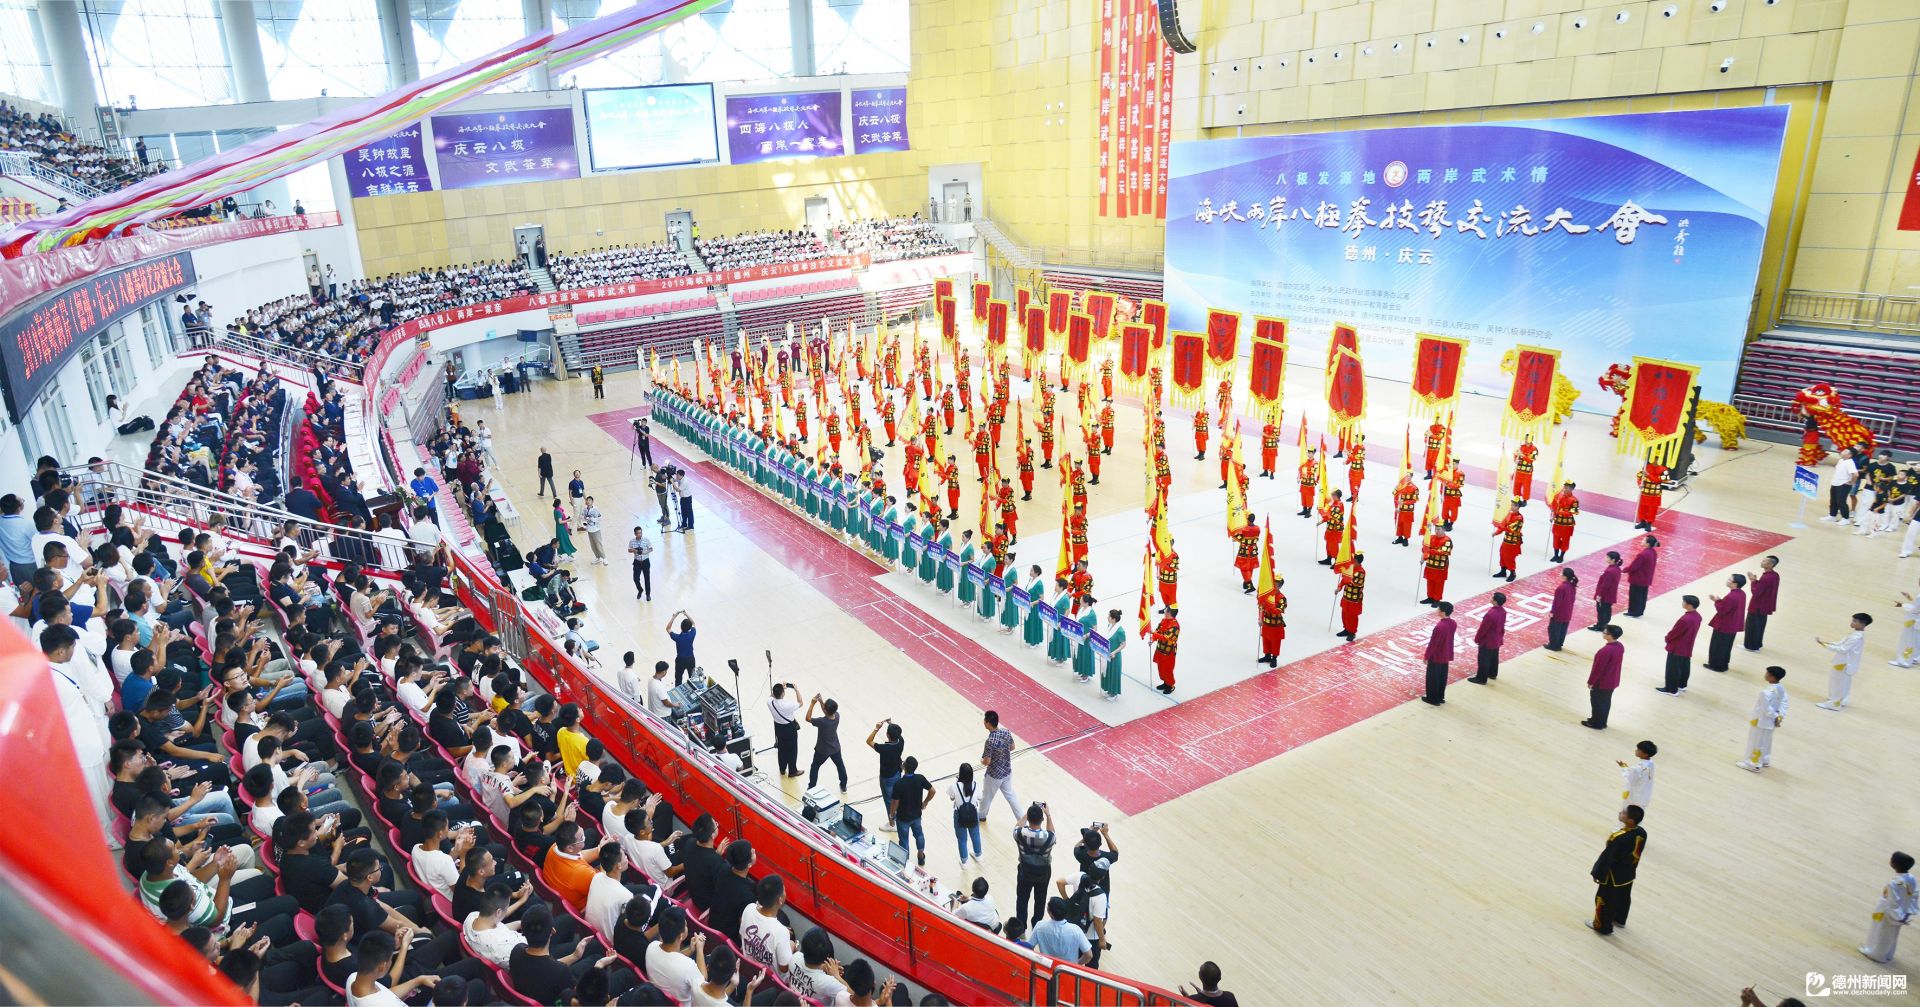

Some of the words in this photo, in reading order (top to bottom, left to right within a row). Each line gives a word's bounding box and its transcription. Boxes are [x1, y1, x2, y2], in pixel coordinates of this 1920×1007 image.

[739, 119, 809, 135] 四海八极人
[858, 113, 901, 127] 庆云八极
[860, 131, 903, 145] 文武荟萃
[358, 146, 412, 162] 吴钟故里
[454, 139, 526, 156] 庆云八极
[362, 162, 415, 178] 八极之源
[485, 157, 555, 174] 文武荟萃
[1276, 171, 1376, 186] 八极发源地
[1417, 166, 1549, 185] 两岸武术情
[366, 180, 420, 197] 吉祥庆云
[1344, 245, 1434, 266] 德州·庆云
[528, 291, 580, 307] 八极发源地
[586, 283, 637, 300] 两岸武术情
[457, 303, 503, 321] 两岸一家亲
[793, 963, 816, 989] TRICK
